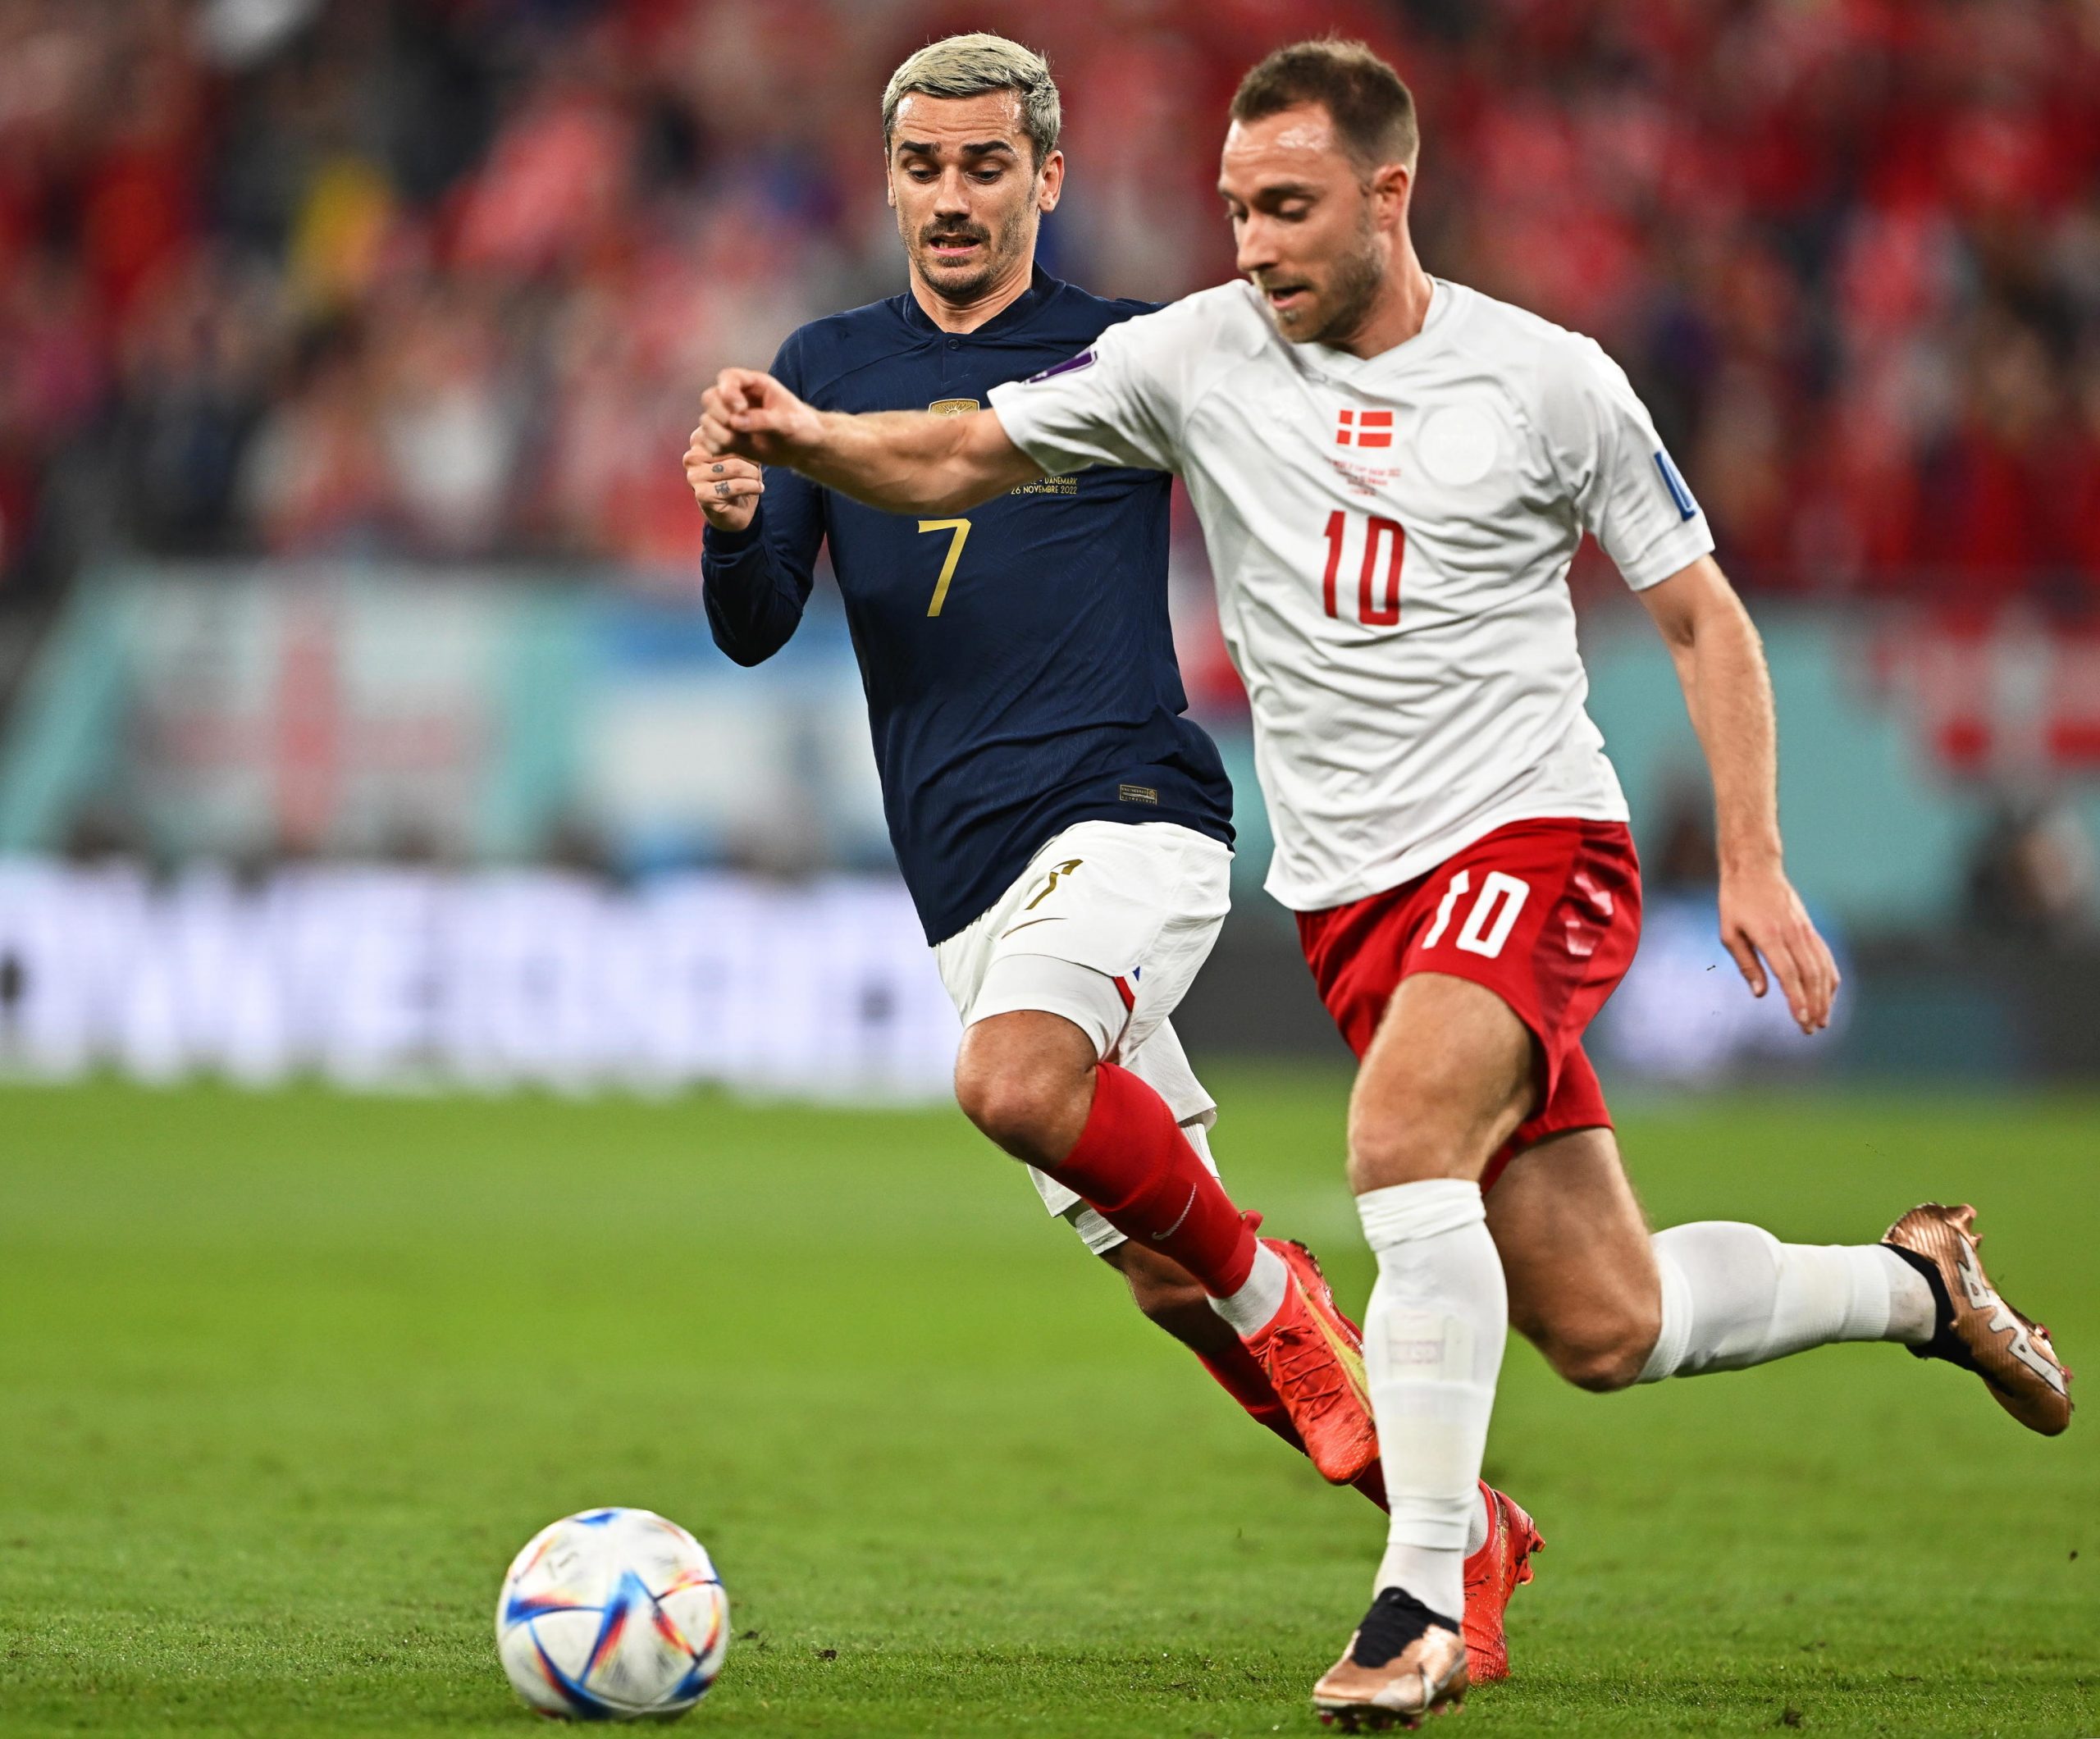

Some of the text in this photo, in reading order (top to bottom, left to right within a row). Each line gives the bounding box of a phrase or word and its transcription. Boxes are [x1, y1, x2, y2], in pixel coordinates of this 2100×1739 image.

[1023, 485, 1058, 494] NOVEMBRE
[1060, 486, 1078, 495] 2022
[1044, 477, 1078, 486] DANEMARK
[917, 518, 972, 618] 7
[1322, 509, 1406, 627] 10
[1421, 869, 1531, 959] 10
